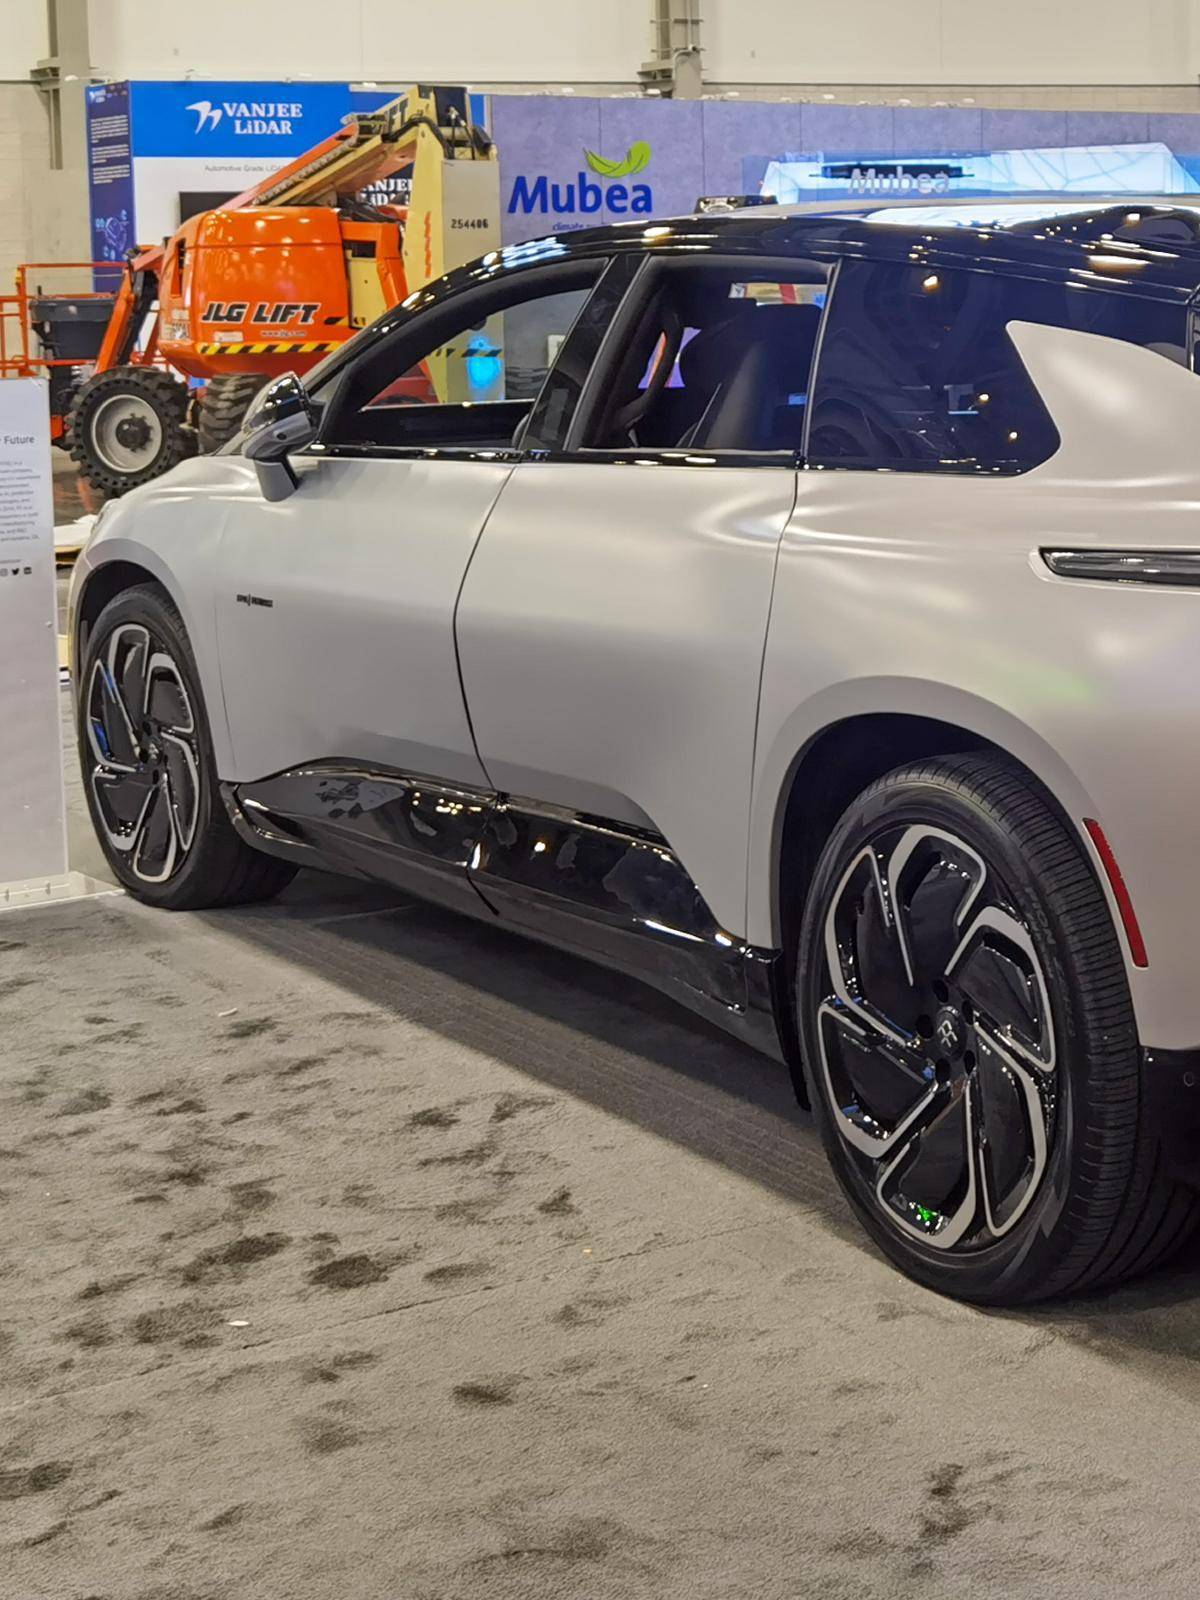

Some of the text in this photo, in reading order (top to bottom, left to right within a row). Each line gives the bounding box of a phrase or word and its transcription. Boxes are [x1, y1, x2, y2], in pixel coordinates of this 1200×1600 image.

[222, 103, 303, 117] VANJEE
[234, 120, 292, 135] LiDAR
[848, 165, 951, 194] Mubea
[507, 171, 653, 214] Mubea
[201, 302, 321, 324] JLG LIFT
[4, 435, 35, 445] Future
